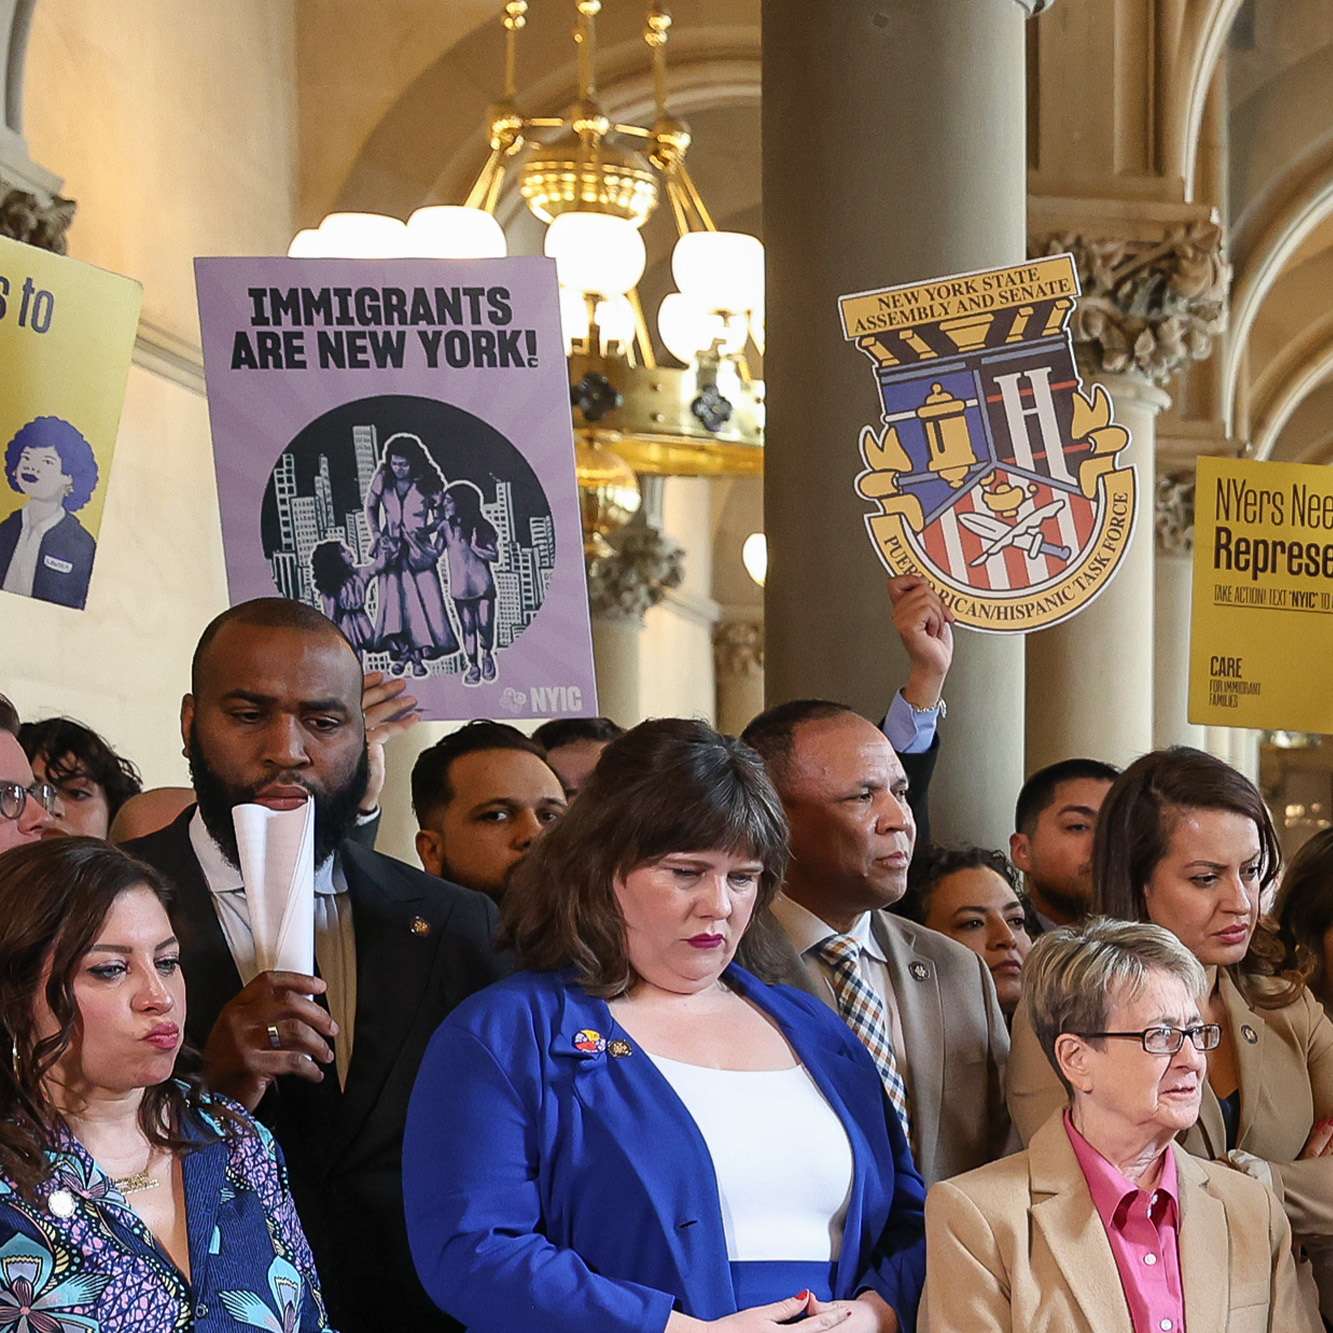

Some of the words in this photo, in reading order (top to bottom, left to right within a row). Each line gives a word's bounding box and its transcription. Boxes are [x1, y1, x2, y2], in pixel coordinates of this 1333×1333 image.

[18, 277, 54, 333] to
[248, 287, 512, 326] IMMIGRANTS
[855, 303, 950, 333] ASSEMBLY
[957, 293, 998, 314] AND
[1000, 278, 1072, 304] SENATE
[878, 290, 920, 311] NEW
[924, 279, 979, 304] YORK
[982, 268, 1040, 290] STATE
[231, 331, 307, 369] ARE
[317, 330, 406, 369] NEW
[417, 330, 538, 368] YORK!
[1215, 477, 1284, 526] NYers
[884, 534, 936, 591] PUER
[938, 585, 1076, 621] RICAN/HISPANIC
[1073, 555, 1111, 592] TASK
[1103, 492, 1128, 554] FORCE
[1214, 584, 1233, 603] TAKE
[1234, 586, 1267, 604] ACTION!
[1269, 588, 1287, 606] TEXT
[1321, 593, 1330, 609] TO
[1210, 656, 1243, 678] CARE
[530, 686, 582, 712] NYIC
[1209, 679, 1223, 693] FOR
[1224, 680, 1261, 695] IMMIGRANT
[1209, 693, 1239, 708] FAMILIES
